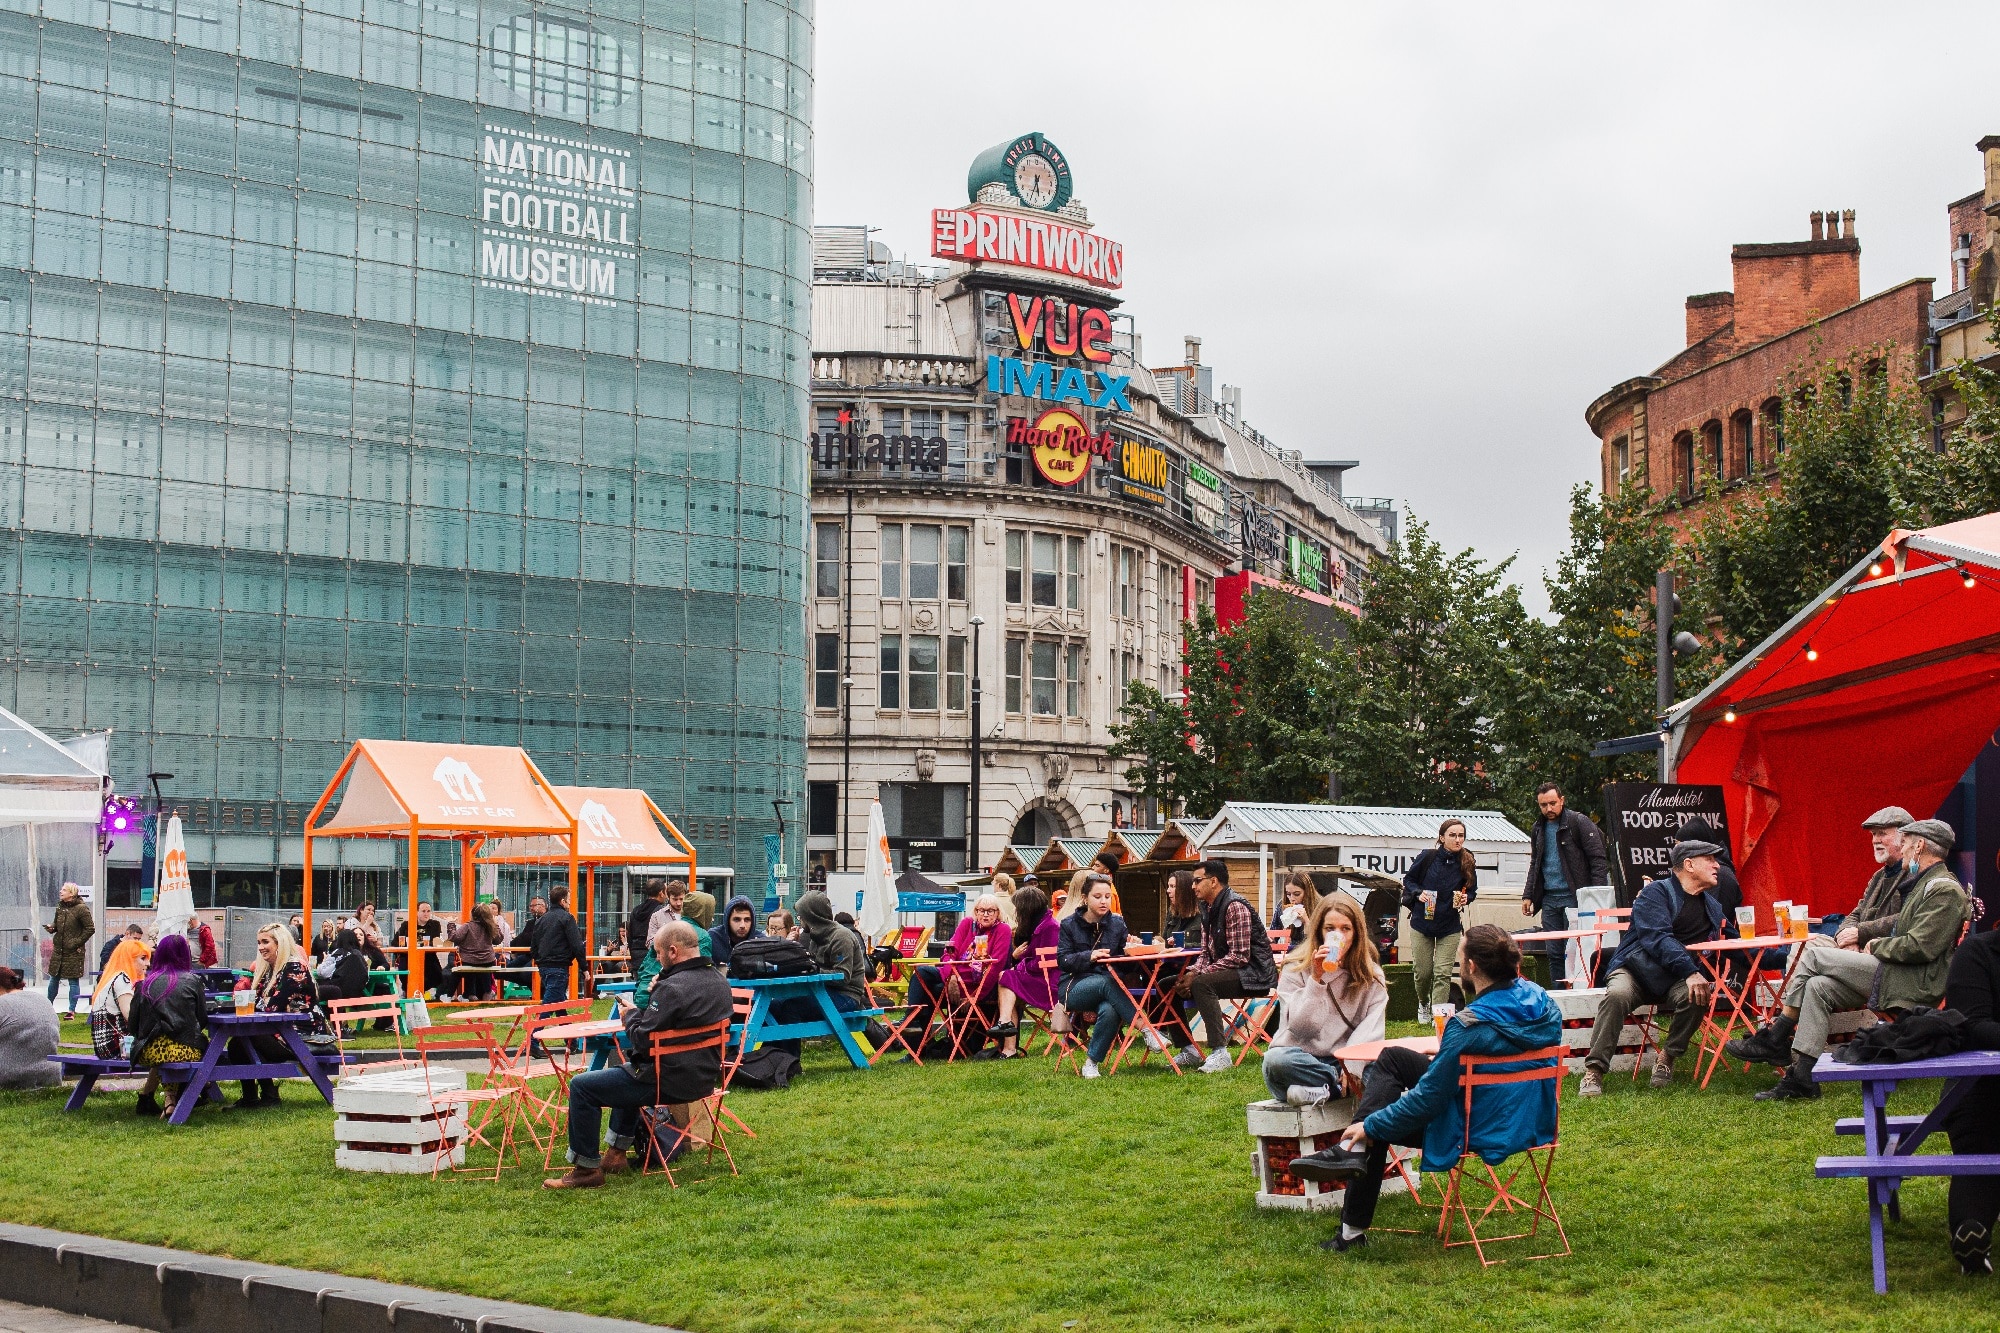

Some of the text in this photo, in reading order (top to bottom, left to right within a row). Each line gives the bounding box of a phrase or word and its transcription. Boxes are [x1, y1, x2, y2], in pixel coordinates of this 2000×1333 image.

[485, 136, 633, 197] NATIONAL
[1006, 140, 1034, 166] PRESS
[484, 188, 634, 245] FOOTBALL
[937, 211, 1122, 285] THE PRINTWORKS
[482, 241, 615, 295] MUSEUM
[988, 355, 1133, 412] IMAX
[1007, 417, 1115, 461] Hard Rock
[1048, 459, 1075, 472] CAFE
[1123, 439, 1167, 489] CHIQUITO
[438, 806, 516, 818] JUST EAT
[1638, 788, 1704, 808] Manchester
[1622, 811, 1662, 829] FOOD
[1676, 812, 1724, 830] DNK
[587, 841, 646, 852] JUST EAT
[1352, 855, 1415, 875] TRUL
